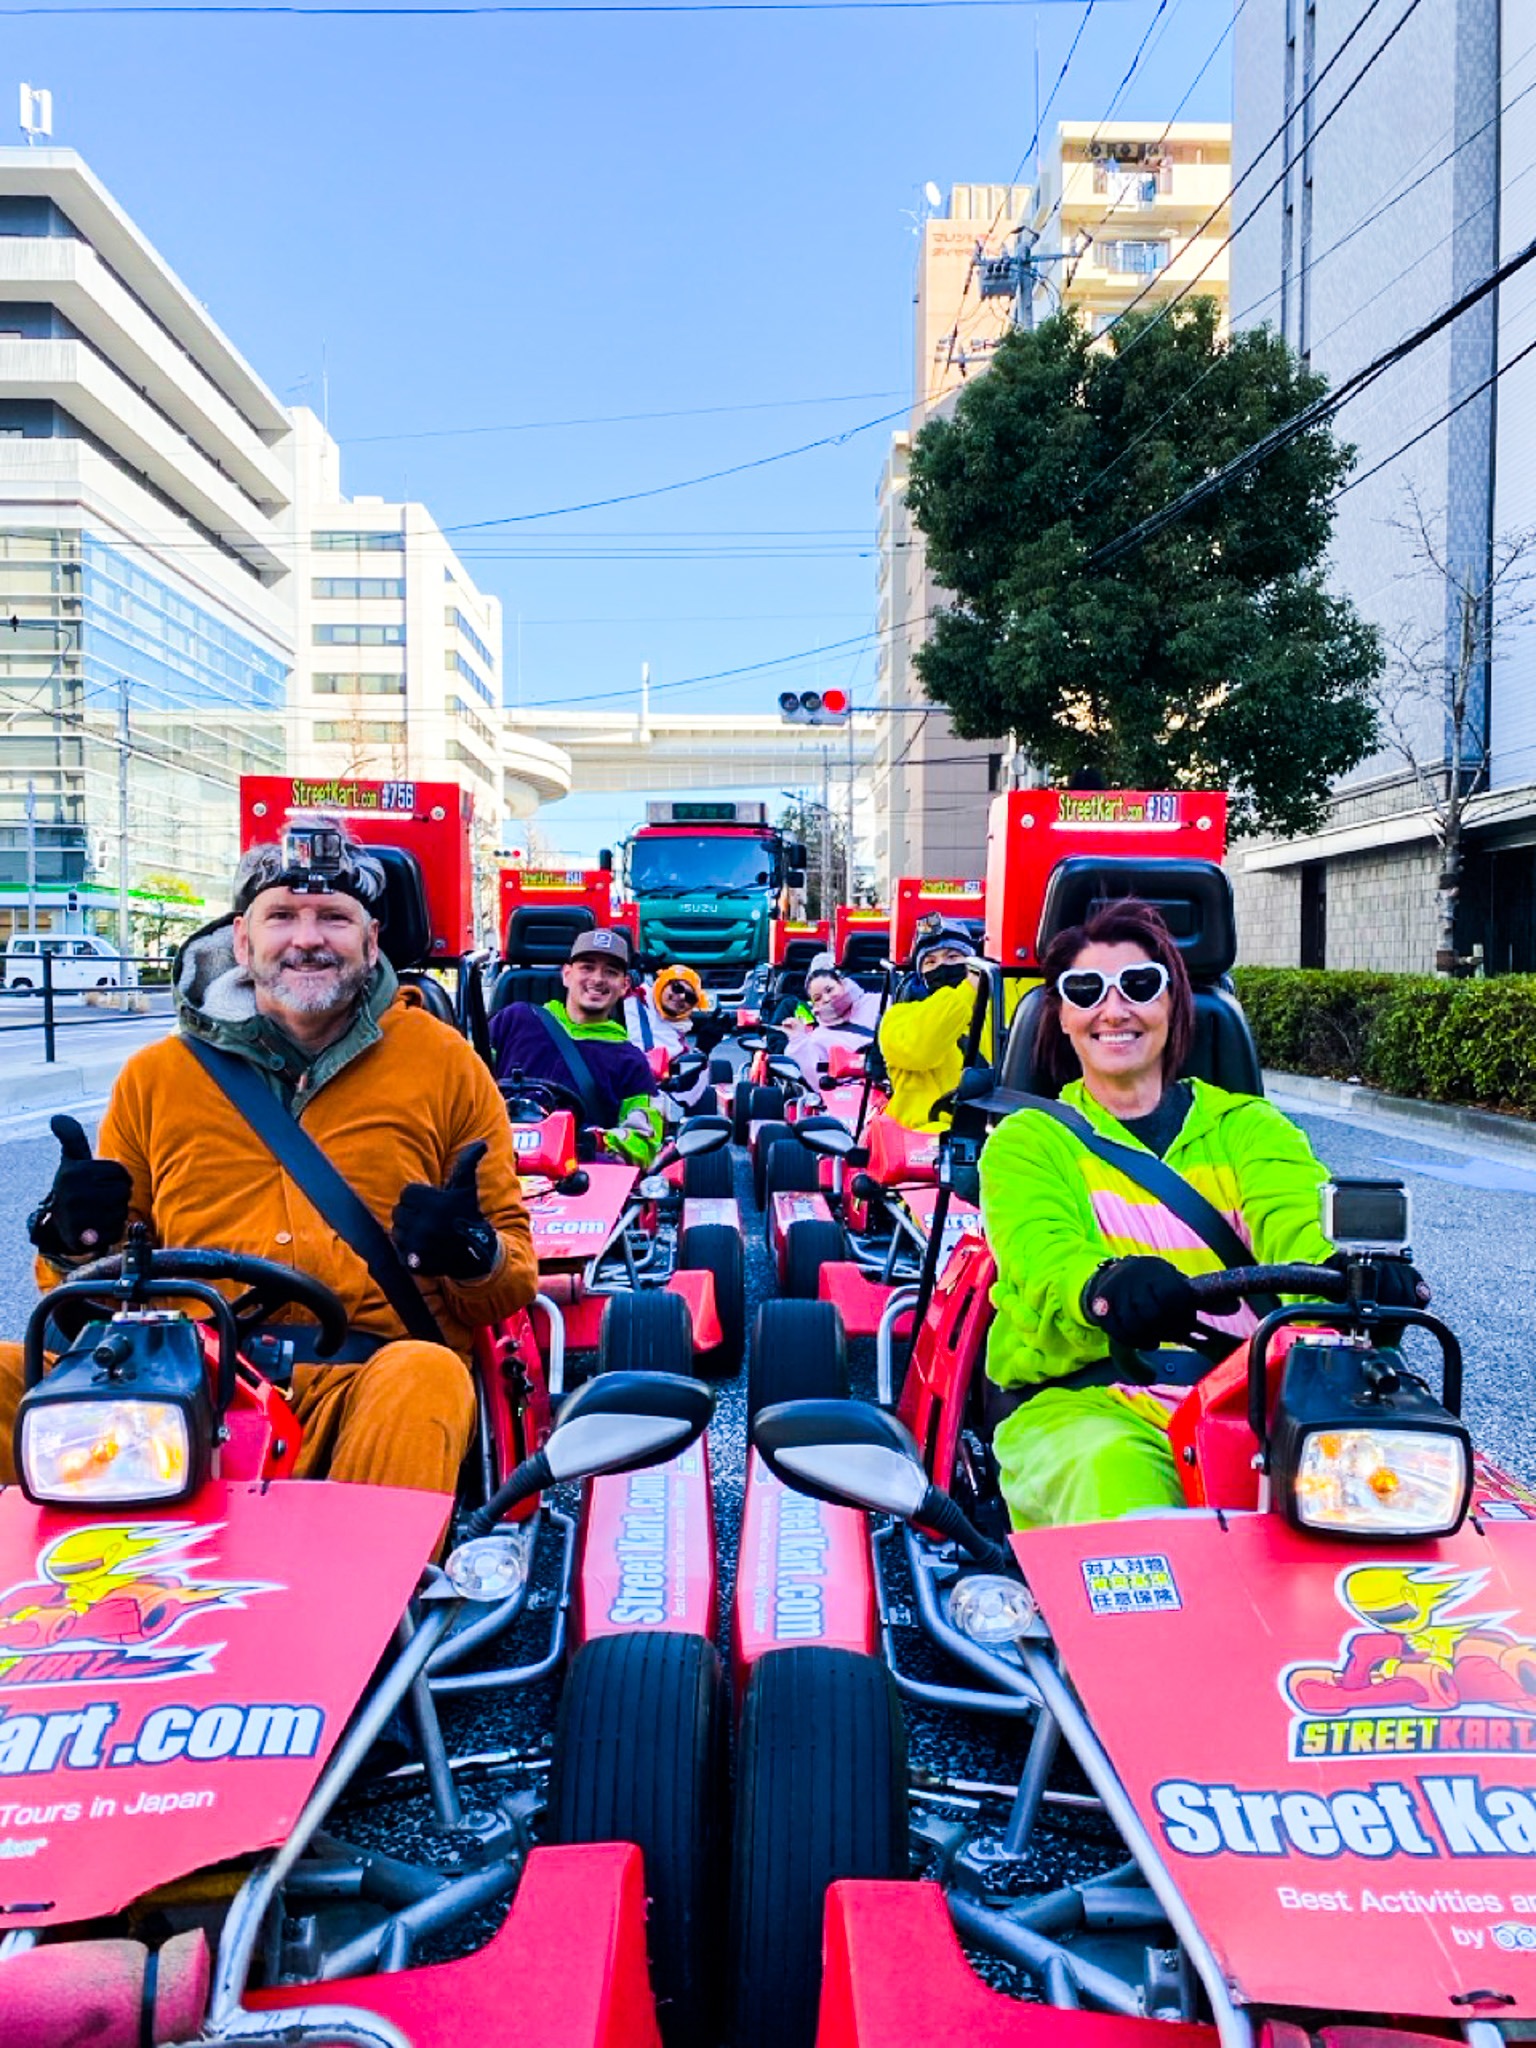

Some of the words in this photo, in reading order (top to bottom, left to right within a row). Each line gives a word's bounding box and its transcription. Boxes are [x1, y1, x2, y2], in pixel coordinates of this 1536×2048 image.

[382, 782, 413, 809] #756
[1145, 795, 1177, 822] #191
[679, 903, 718, 913] ISUZU
[608, 1553, 669, 1625] Street
[774, 1535, 829, 1641] Kart.com
[0, 1701, 325, 1777] art.com
[0, 1803, 81, 1828] Tours
[90, 1797, 115, 1819] in
[123, 1790, 215, 1816] Japan
[1151, 1779, 1441, 1859] Street
[1277, 1886, 1353, 1912] Best
[1361, 1889, 1505, 1913] Activities
[1450, 1925, 1485, 1950] by
